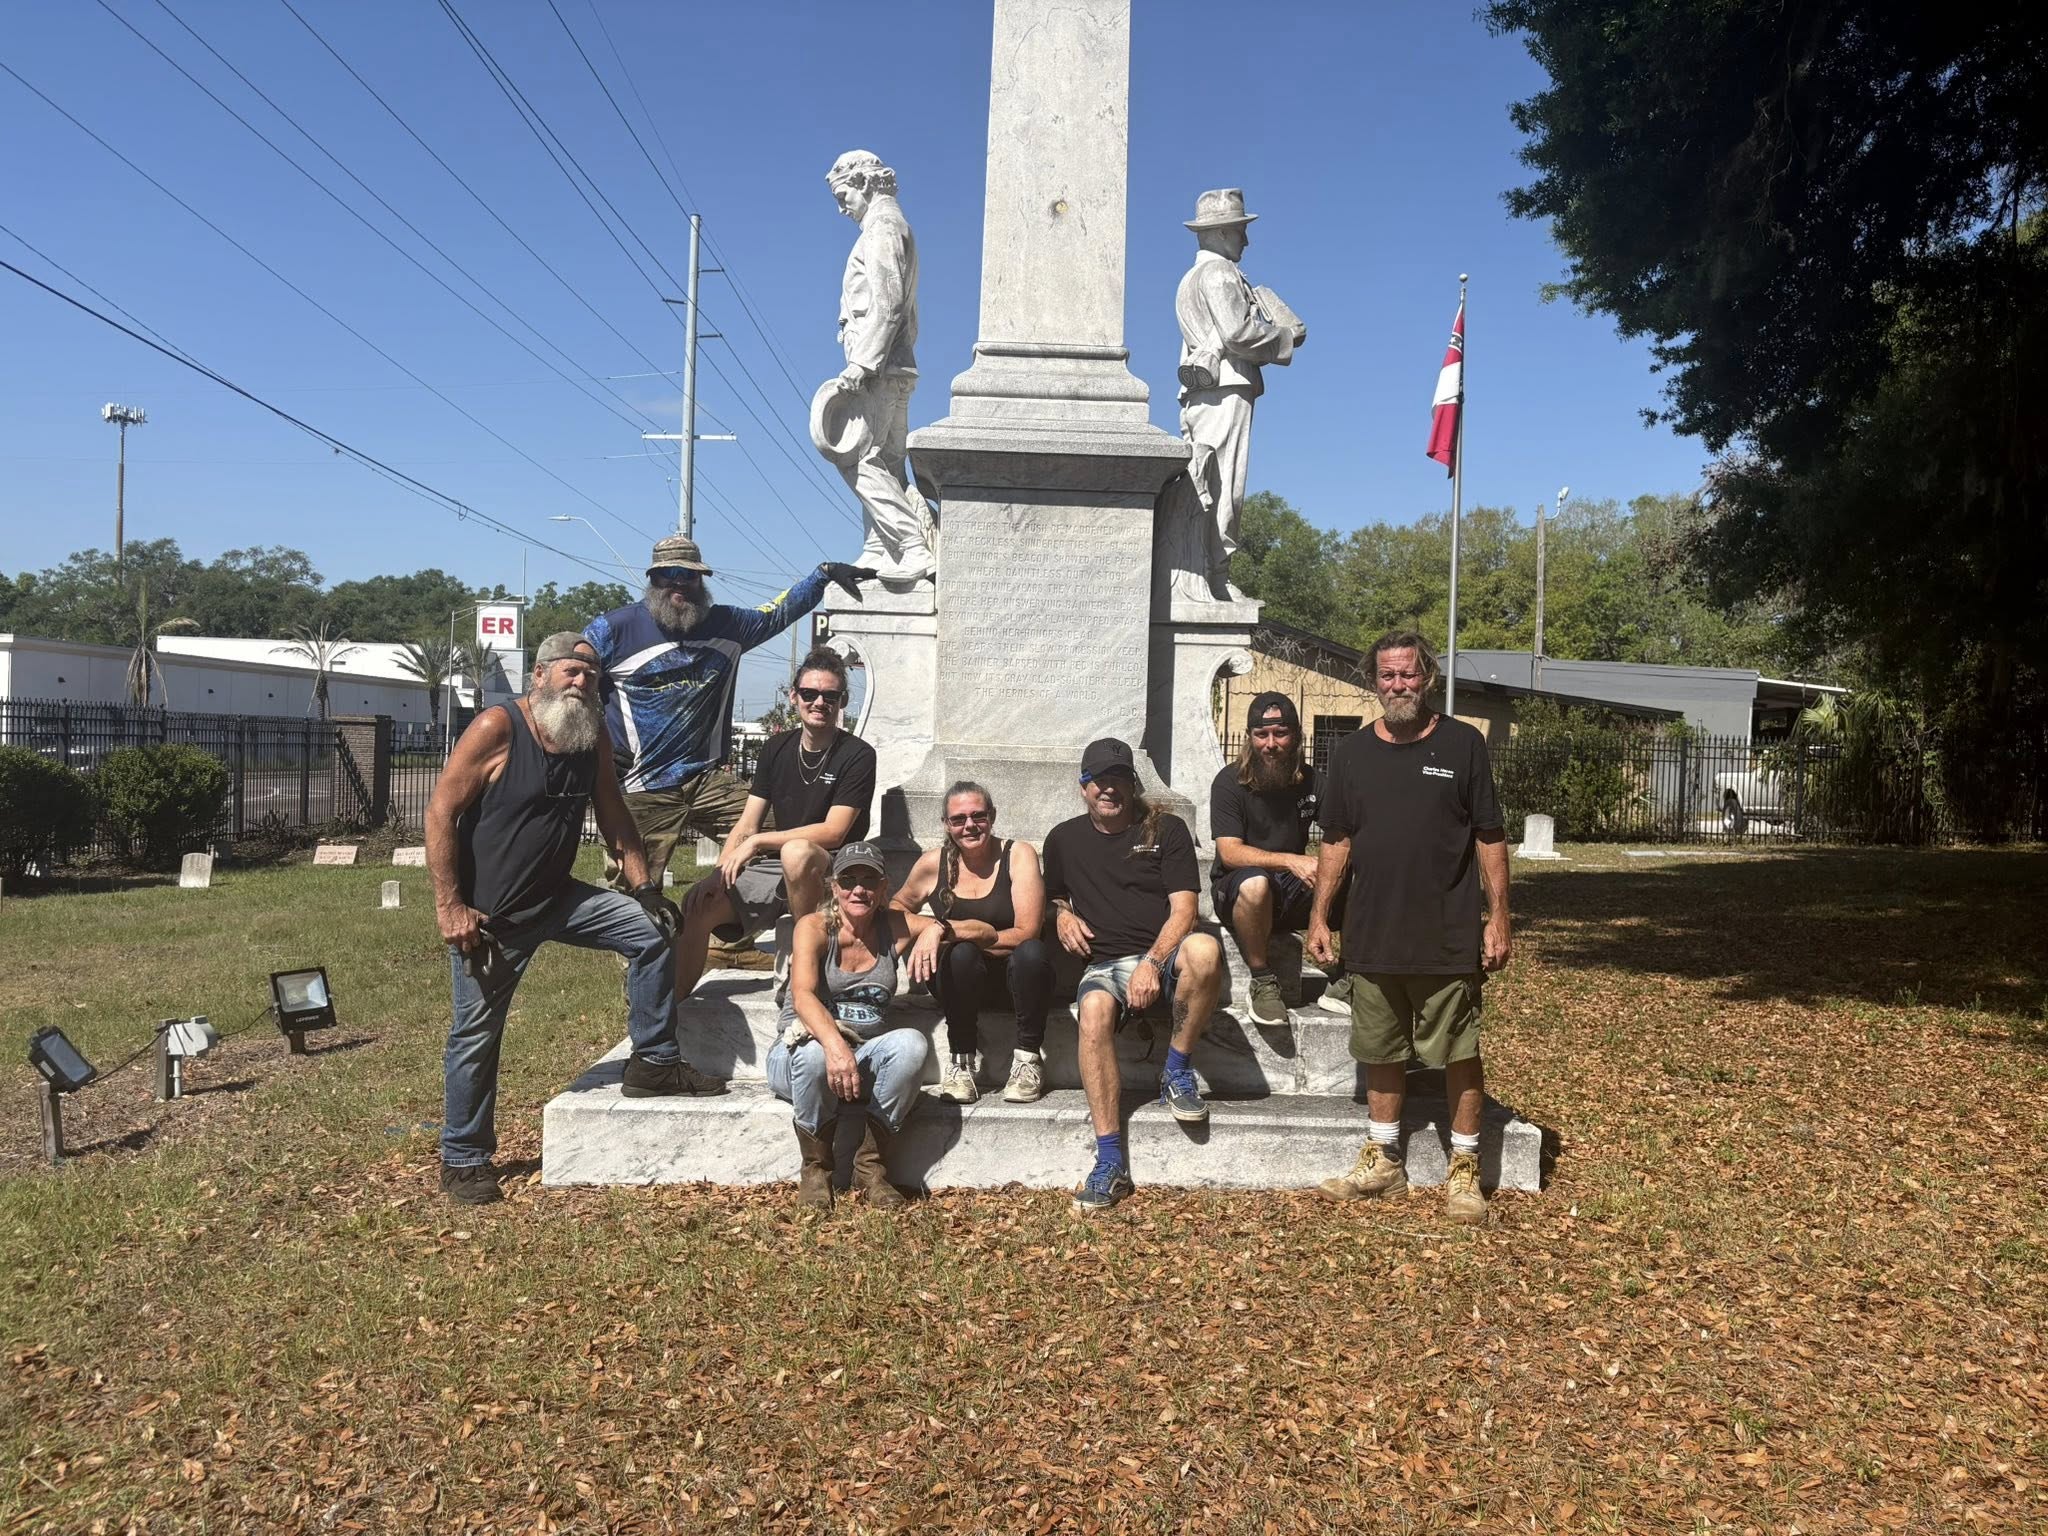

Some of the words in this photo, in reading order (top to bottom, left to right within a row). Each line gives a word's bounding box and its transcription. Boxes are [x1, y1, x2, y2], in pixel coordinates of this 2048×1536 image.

[964, 521, 998, 531] THEIRS
[1001, 521, 1020, 532] THE
[969, 536, 1015, 547] RECKLESS
[1068, 540, 1089, 549] TIES
[947, 550, 965, 560] BUT
[1012, 552, 1049, 563] BEACON
[1094, 555, 1110, 565] THE
[968, 566, 1000, 577] WHERE
[1006, 567, 1061, 578] DAUNTLESS
[1066, 569, 1093, 580] DUTY
[1048, 583, 1073, 595] THEY
[948, 596, 977, 606] WHERE
[1066, 599, 1109, 610] BANNERS
[943, 610, 978, 621] BEYOND
[482, 617, 514, 634] ER
[964, 626, 998, 637] BEHIND
[940, 640, 959, 650] THE
[997, 642, 1025, 653] THEIR
[940, 655, 958, 666] THE
[961, 656, 999, 667] BANNER
[1042, 659, 1066, 669] WITH
[940, 671, 958, 681] BUT
[961, 671, 981, 681] NOW
[975, 687, 994, 697] THE
[999, 688, 1035, 698] HEROES
[1040, 689, 1051, 699] OF
[1056, 689, 1061, 699] A
[846, 845, 873, 857] FLA
